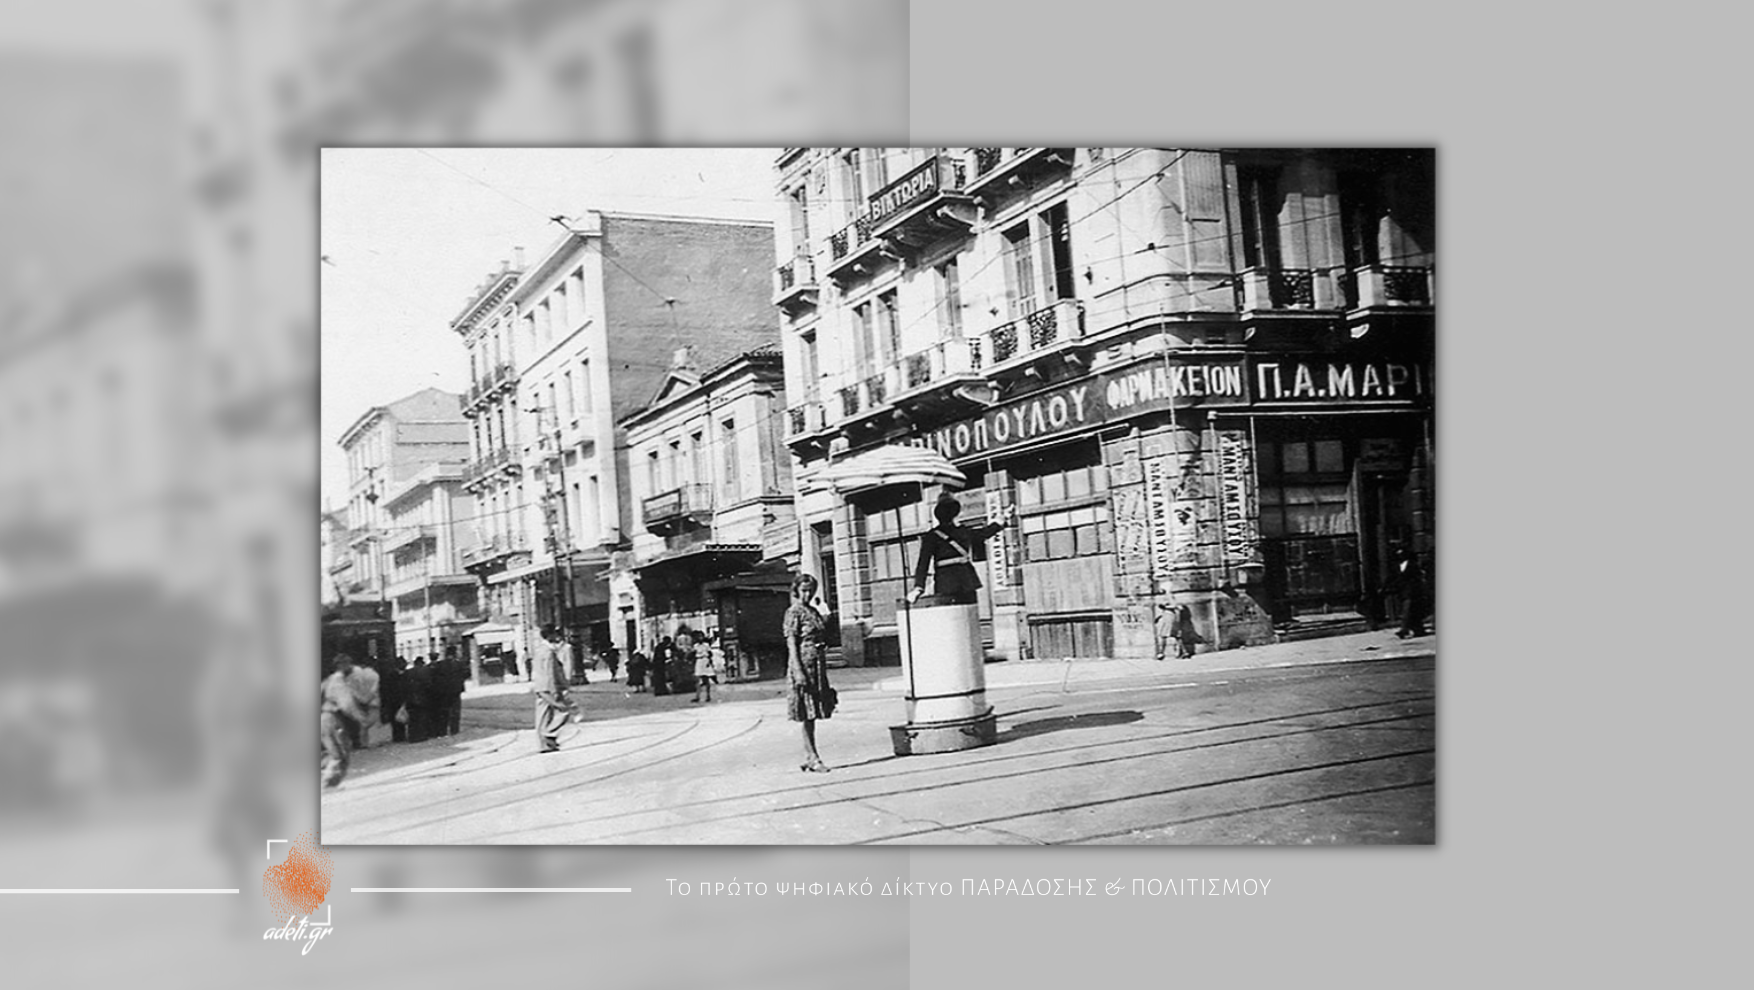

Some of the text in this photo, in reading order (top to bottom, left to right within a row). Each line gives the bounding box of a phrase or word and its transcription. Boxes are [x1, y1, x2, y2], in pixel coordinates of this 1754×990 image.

[871, 167, 934, 220] ΒΙΚΤΩΡΙΑ
[1106, 364, 1242, 410] ΦΑΡΜΑΚΕΙΟΝ
[1257, 362, 1435, 399] Π.Α.ΜΑΡΙ
